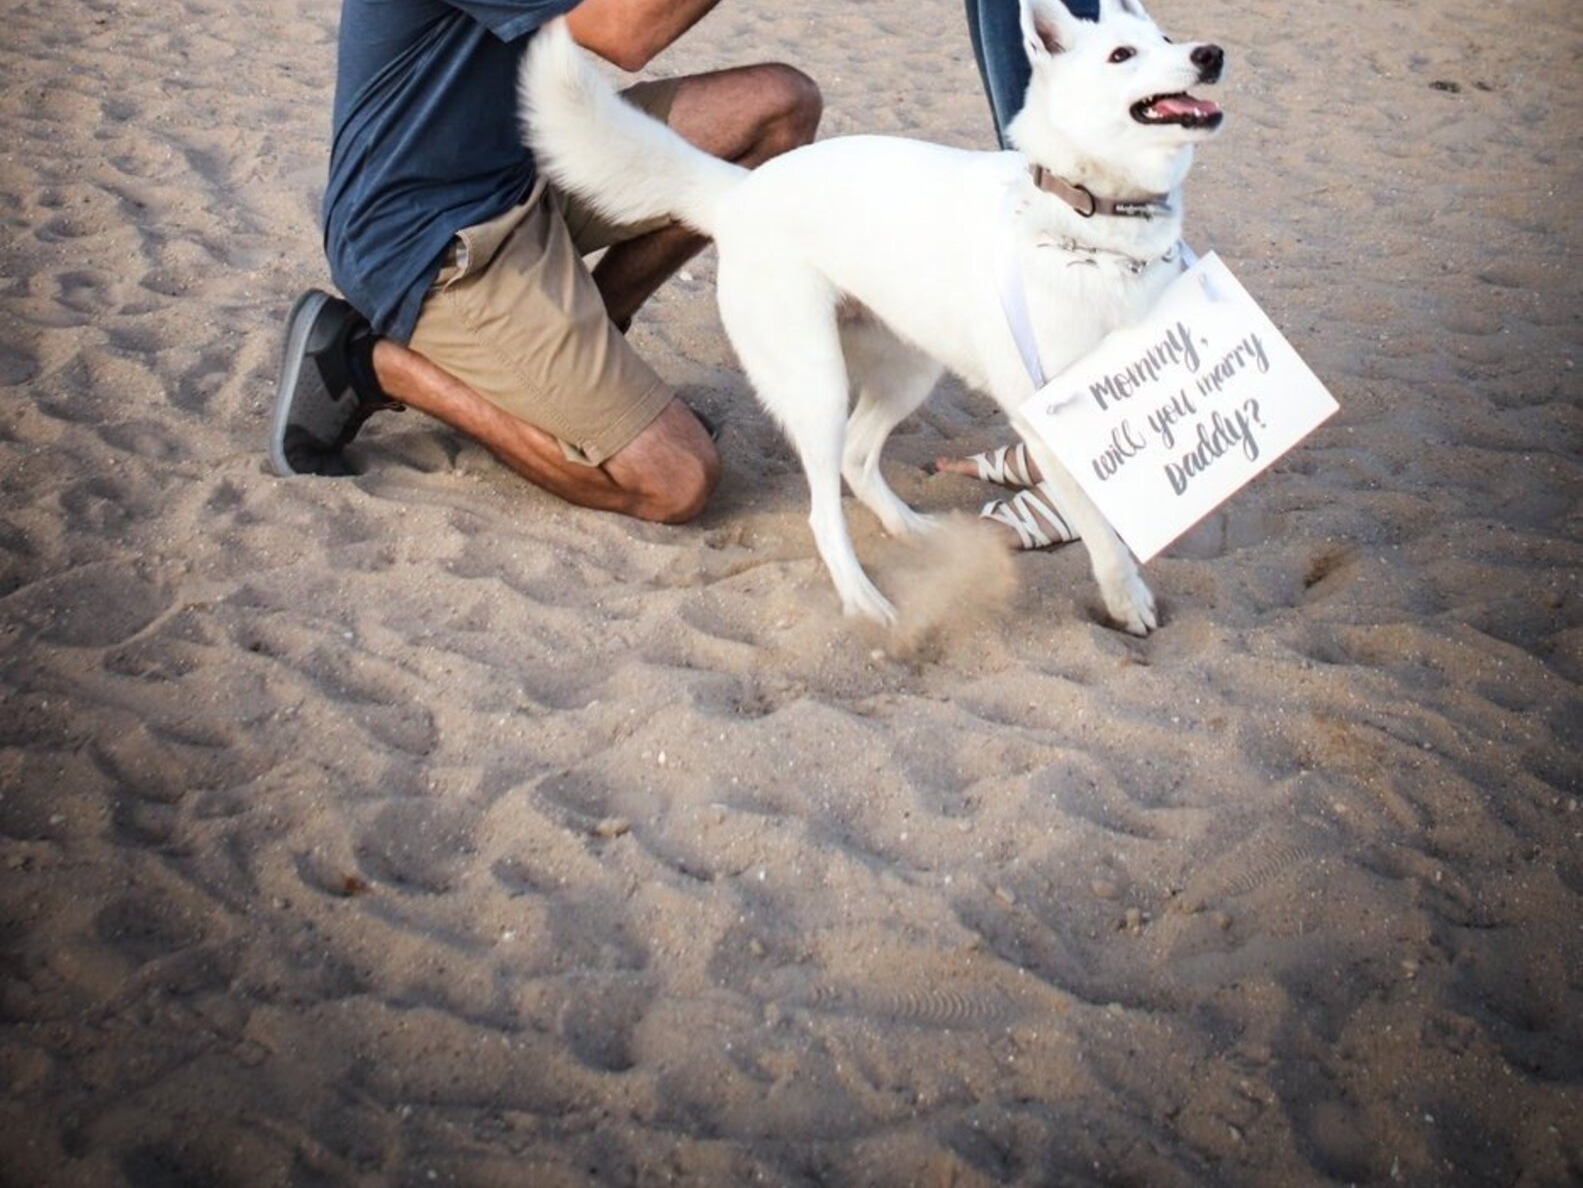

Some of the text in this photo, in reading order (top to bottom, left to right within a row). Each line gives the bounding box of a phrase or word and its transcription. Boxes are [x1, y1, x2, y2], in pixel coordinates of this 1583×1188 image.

[1088, 321, 1208, 412] Mommy,
[1092, 332, 1270, 481] will you marry
[1163, 399, 1267, 497] Daddy?
